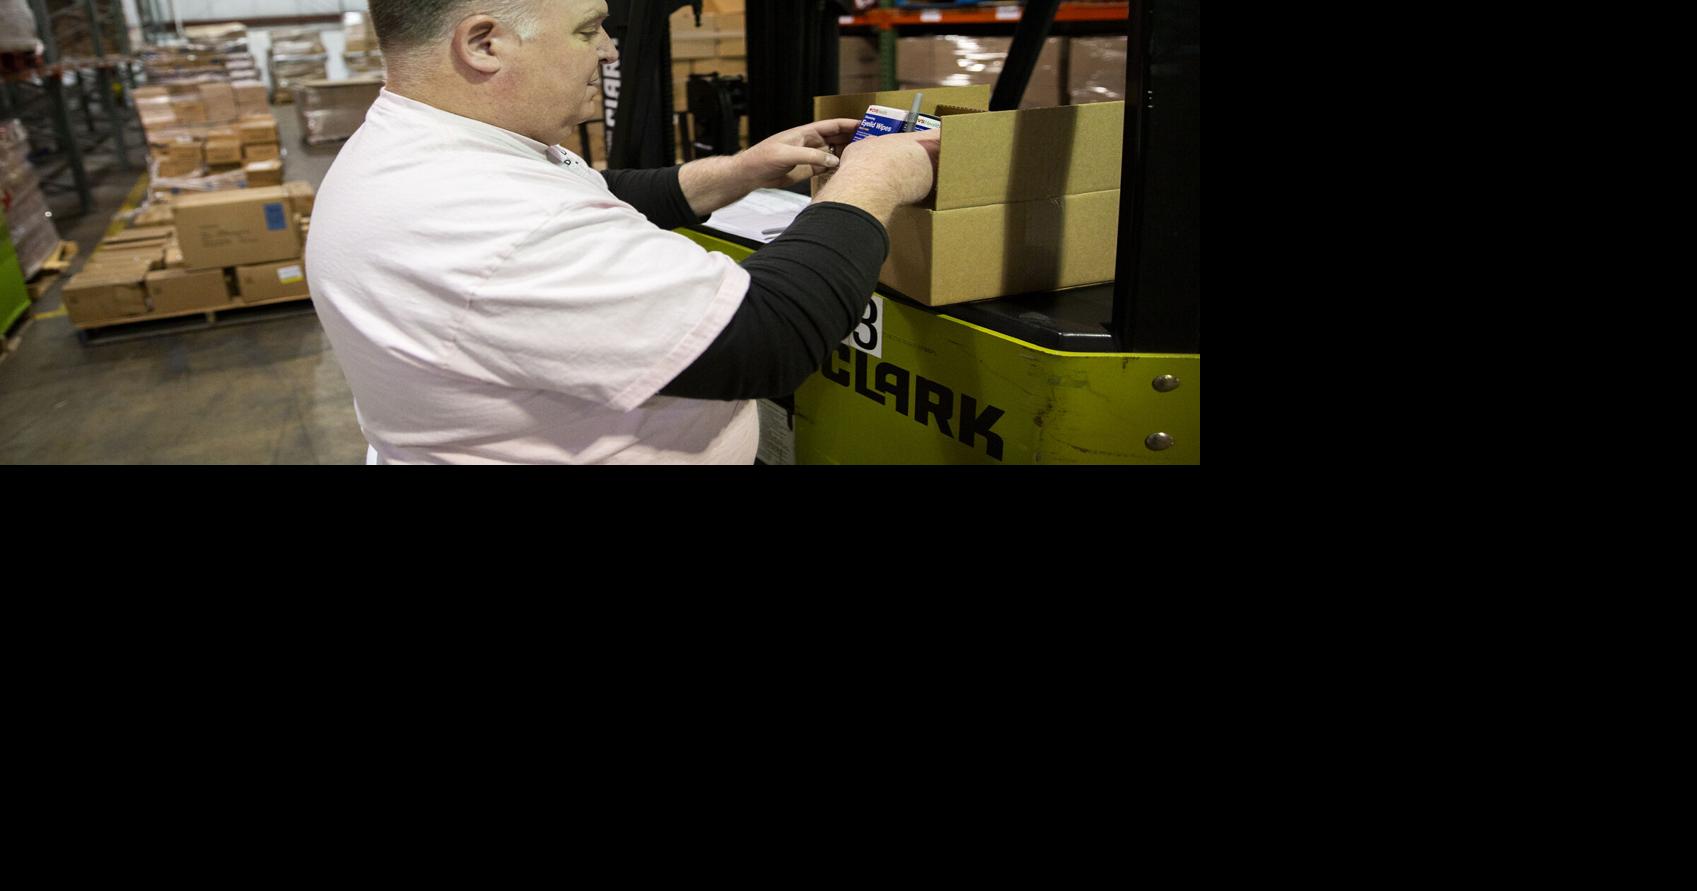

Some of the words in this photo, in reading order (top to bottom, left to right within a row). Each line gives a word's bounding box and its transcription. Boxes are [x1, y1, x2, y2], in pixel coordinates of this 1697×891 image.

[602, 37, 622, 128] CLAR
[861, 119, 876, 128] Eyelid
[876, 122, 892, 132] Wipes
[821, 344, 1006, 462] CLARK
